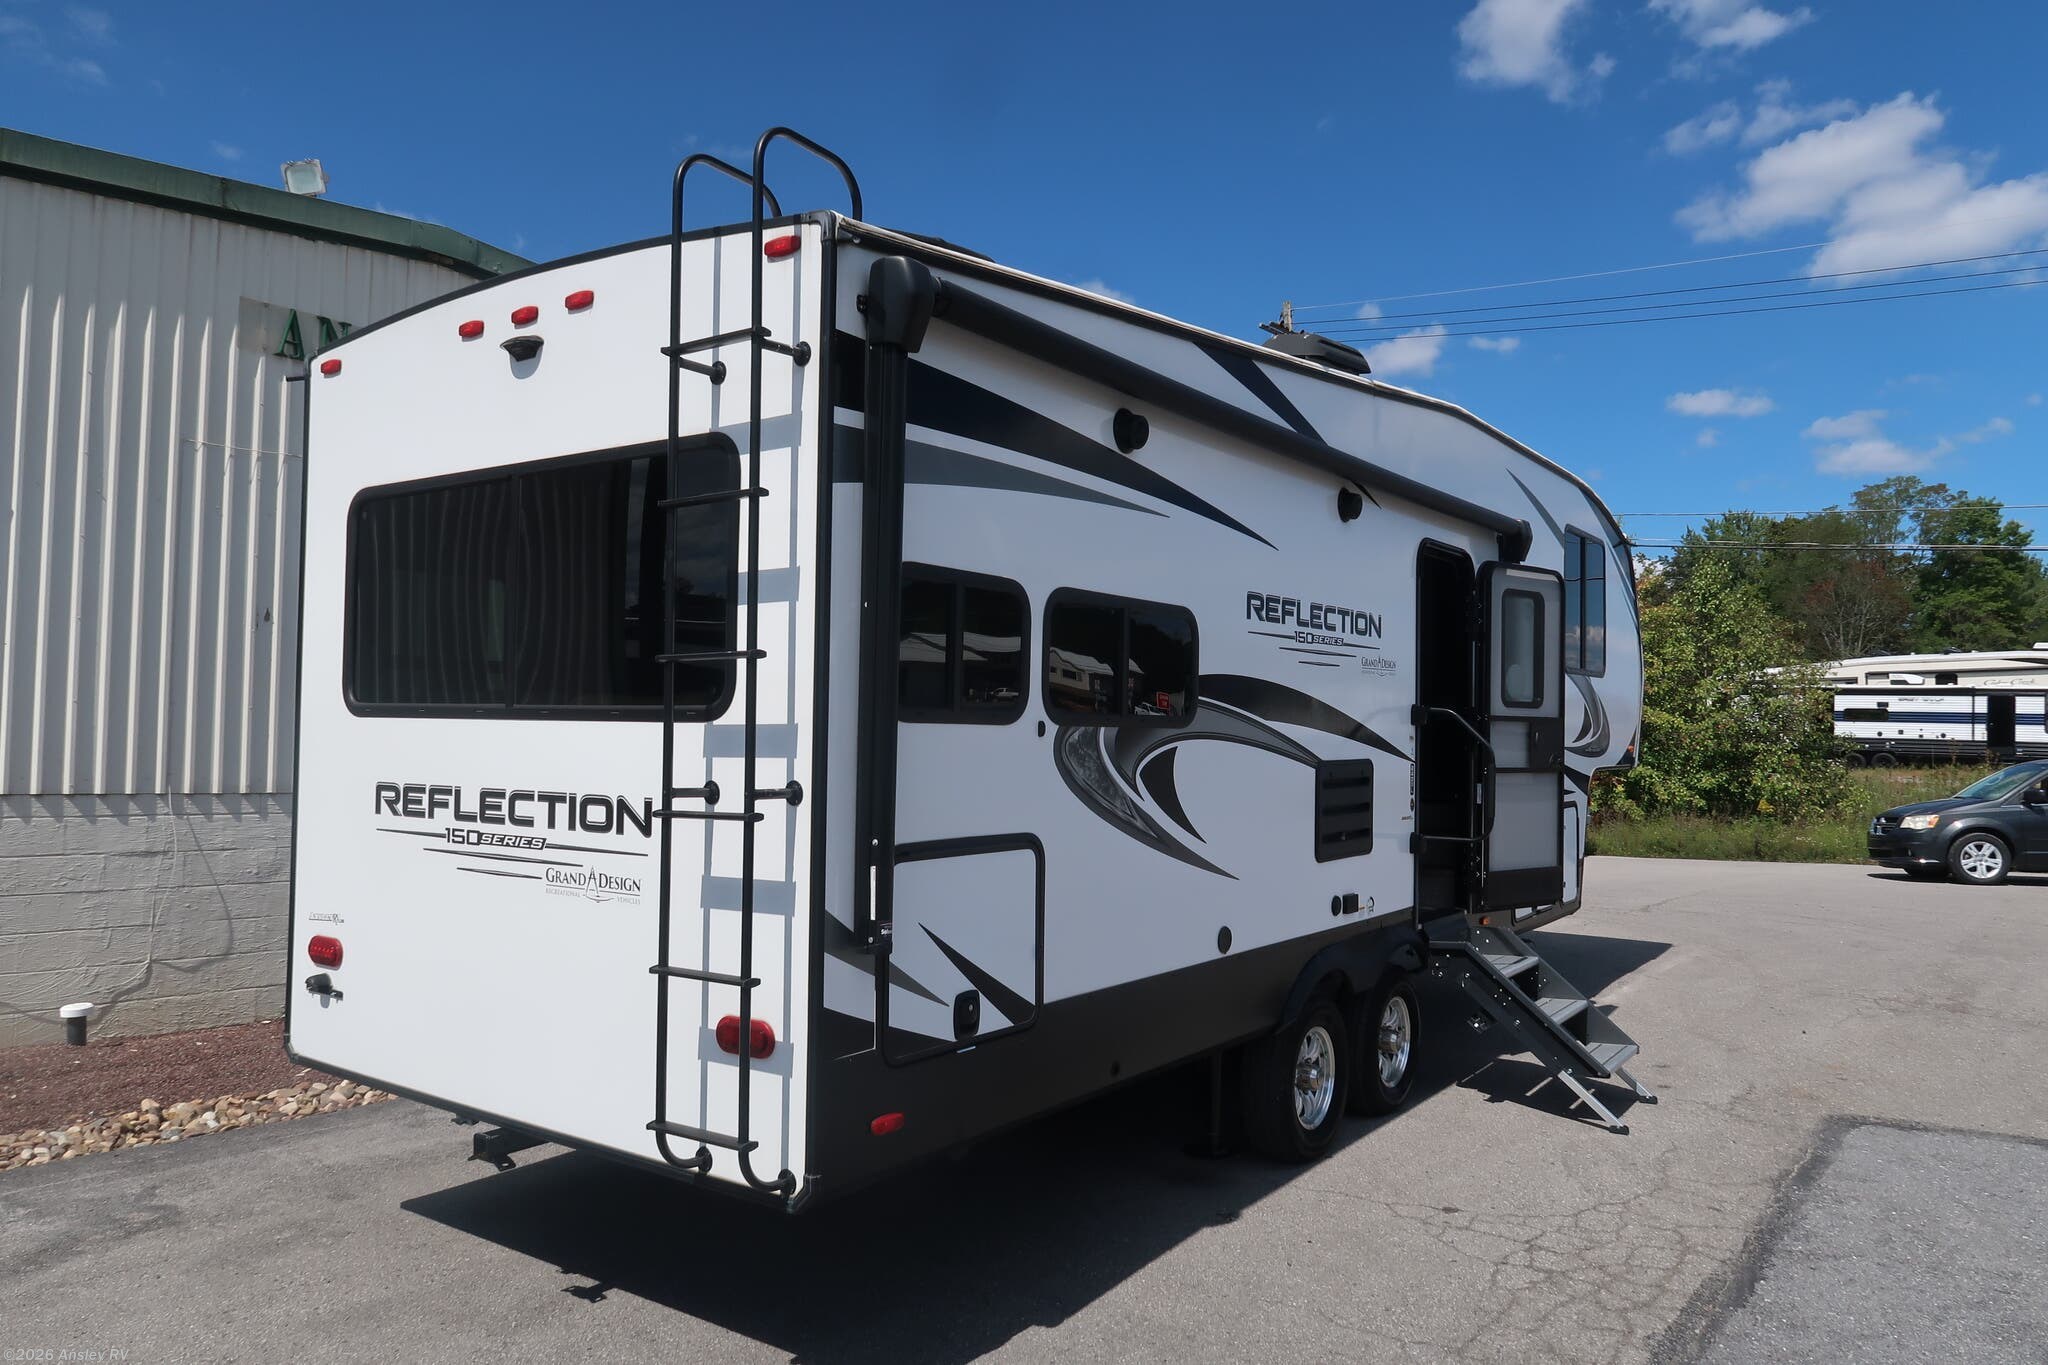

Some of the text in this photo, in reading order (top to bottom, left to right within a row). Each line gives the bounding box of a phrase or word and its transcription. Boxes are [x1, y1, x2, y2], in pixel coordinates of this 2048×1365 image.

[1246, 590, 1382, 639] REFLECTION
[375, 781, 653, 839] REFLECTION
[545, 867, 641, 892] GRAND DESIGN
